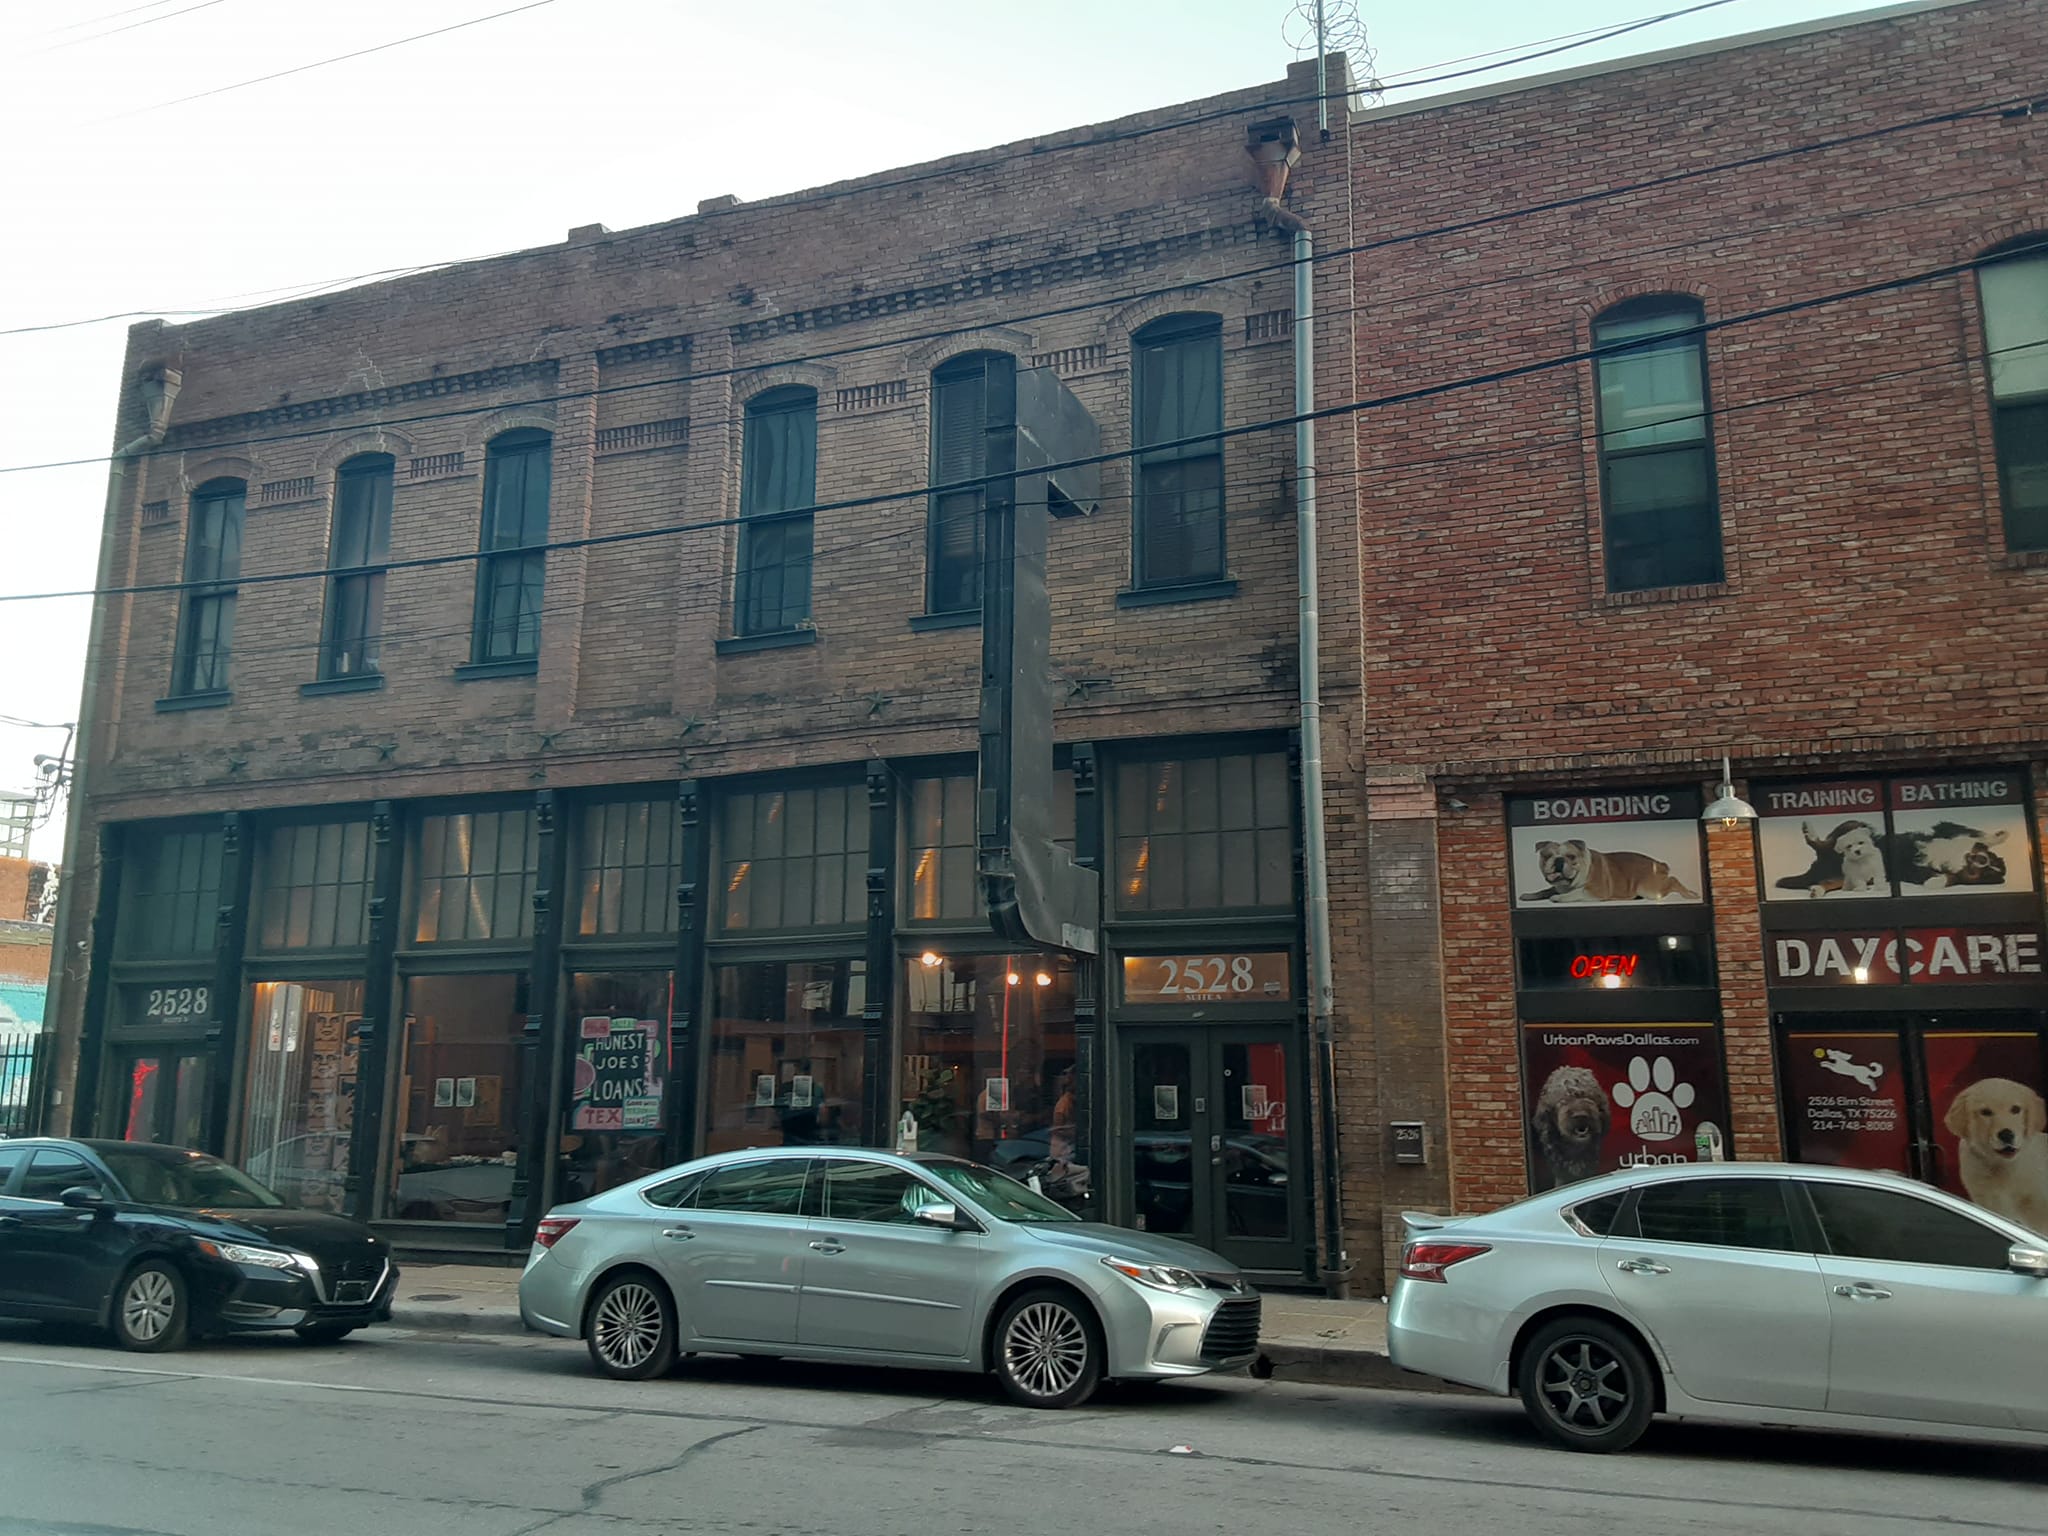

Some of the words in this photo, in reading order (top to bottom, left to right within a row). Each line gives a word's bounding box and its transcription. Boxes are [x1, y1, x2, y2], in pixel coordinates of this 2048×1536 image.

[1768, 788, 1875, 809] TRAINING
[1900, 781, 2008, 802] BATHING
[1533, 795, 1671, 820] BOARDING
[1776, 934, 2042, 977] DAYCARE
[1159, 956, 1254, 994] 2528
[1570, 954, 1639, 979] OPEN
[147, 987, 208, 1016] 2528
[595, 1032, 645, 1051] HONEST
[1543, 1033, 1700, 1046] UrbanPawsDallas.com
[595, 1056, 640, 1070] JOES
[592, 1079, 644, 1101] LOANS
[1807, 1096, 1835, 1106] 2526
[1836, 1096, 1858, 1106] Elm
[1859, 1096, 1895, 1106] Street
[1807, 1108, 1846, 1119] Dallas,
[1846, 1109, 1861, 1118] TX
[1863, 1109, 1897, 1119] 75226
[1619, 1145, 1688, 1167] urban
